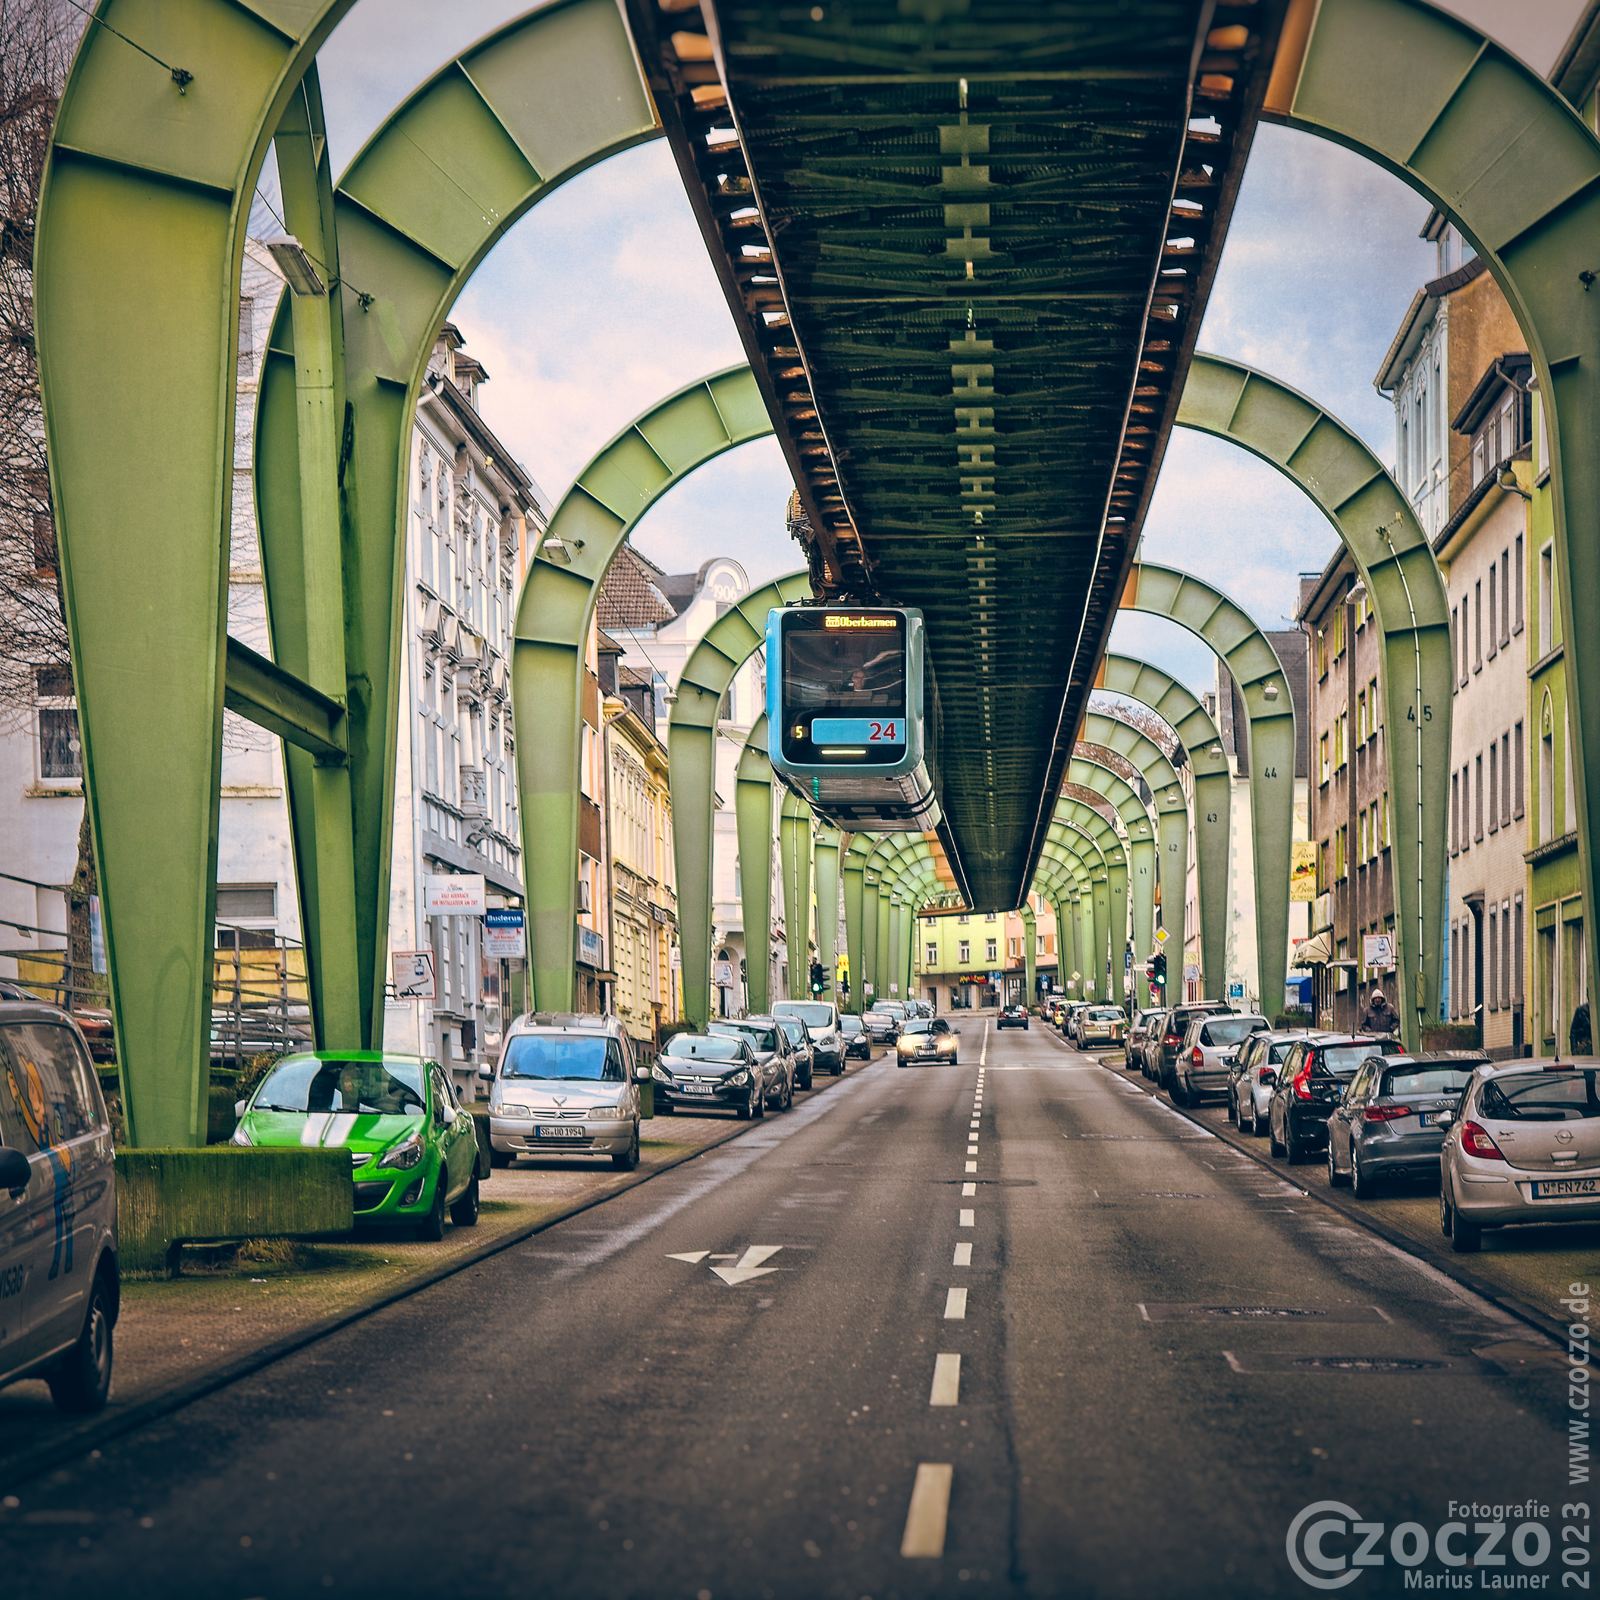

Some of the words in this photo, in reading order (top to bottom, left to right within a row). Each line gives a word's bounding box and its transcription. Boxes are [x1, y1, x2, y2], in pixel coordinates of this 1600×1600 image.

[840, 616, 897, 627] Oberbarmen
[1407, 705, 1433, 722] 45
[795, 725, 803, 739] 5
[869, 722, 896, 741] 24
[1264, 767, 1277, 779] 44
[1207, 813, 1218, 823] 43
